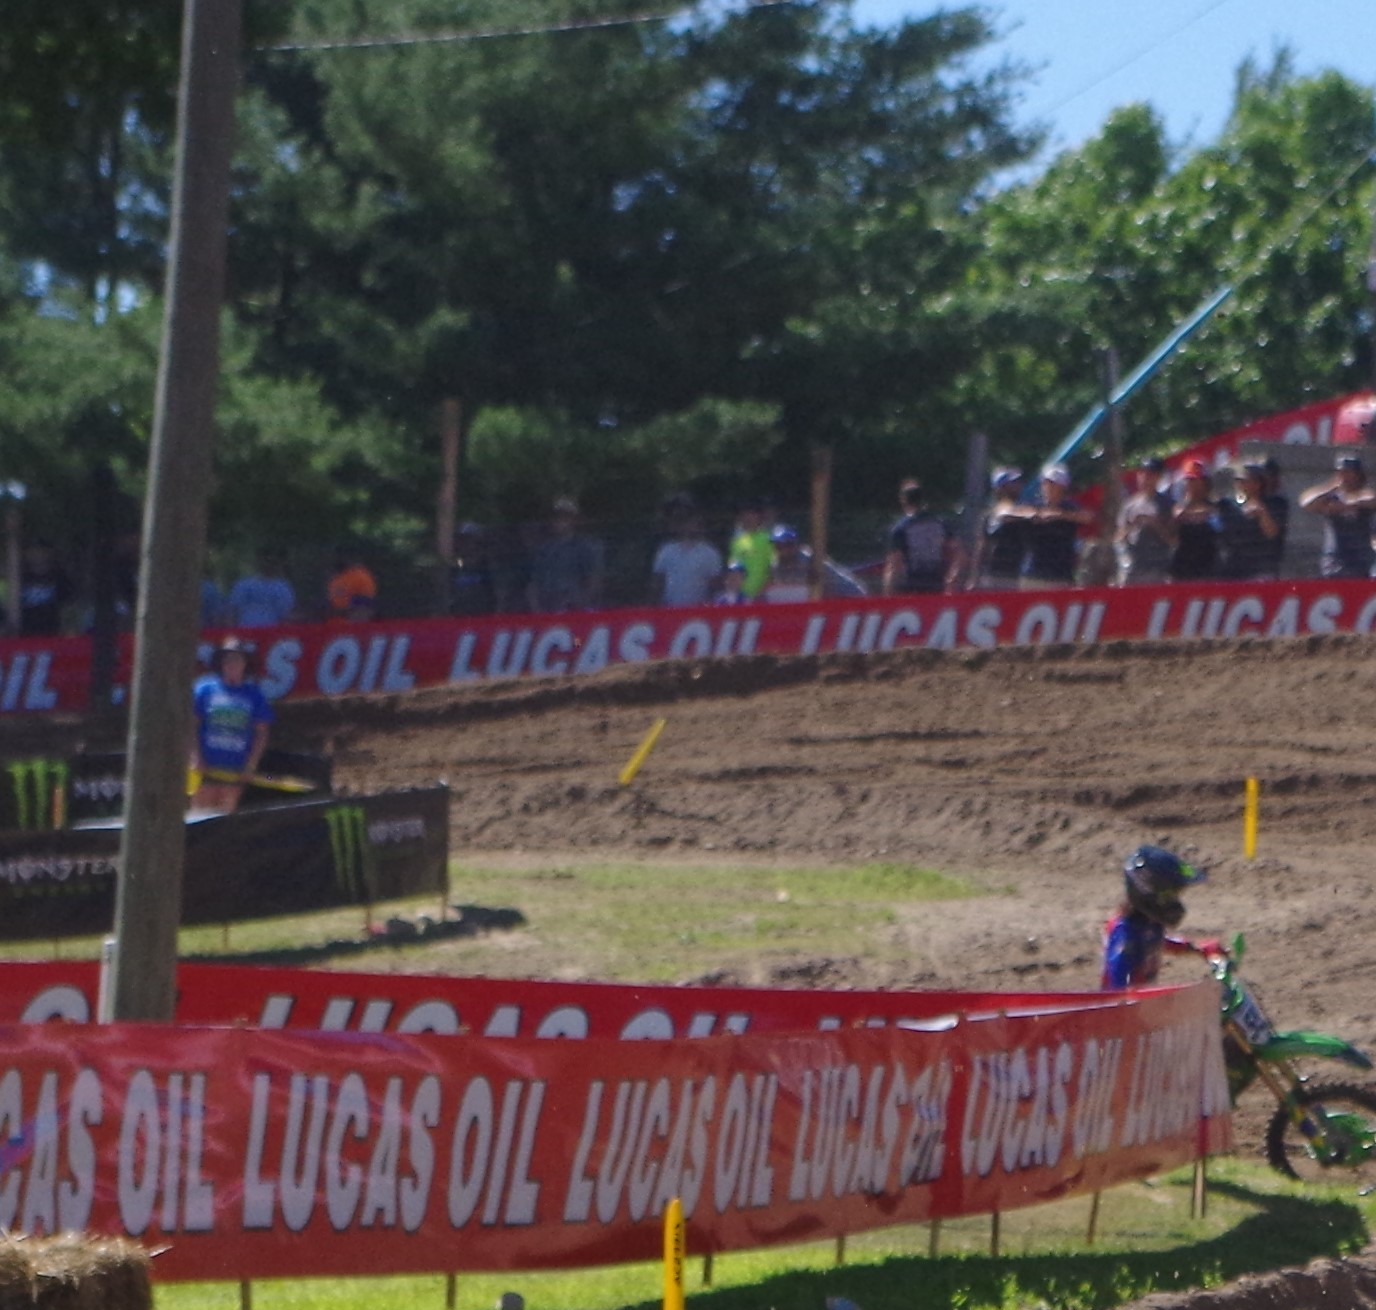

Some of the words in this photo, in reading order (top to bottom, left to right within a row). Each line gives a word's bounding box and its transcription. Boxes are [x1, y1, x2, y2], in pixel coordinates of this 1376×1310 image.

[315, 634, 415, 696] OIL
[447, 622, 655, 681] LUCAS
[0, 654, 58, 712] IL
[118, 1068, 214, 1235] OIL
[242, 1071, 441, 1231] LUCAS
[447, 1074, 545, 1228] OIL
[562, 1074, 715, 1224] LUCAS
[713, 1072, 777, 1214] OIL
[789, 1063, 903, 1201] LUCAS
[960, 1040, 1074, 1180] LUCAS
[1071, 1036, 1123, 1159] OIL
